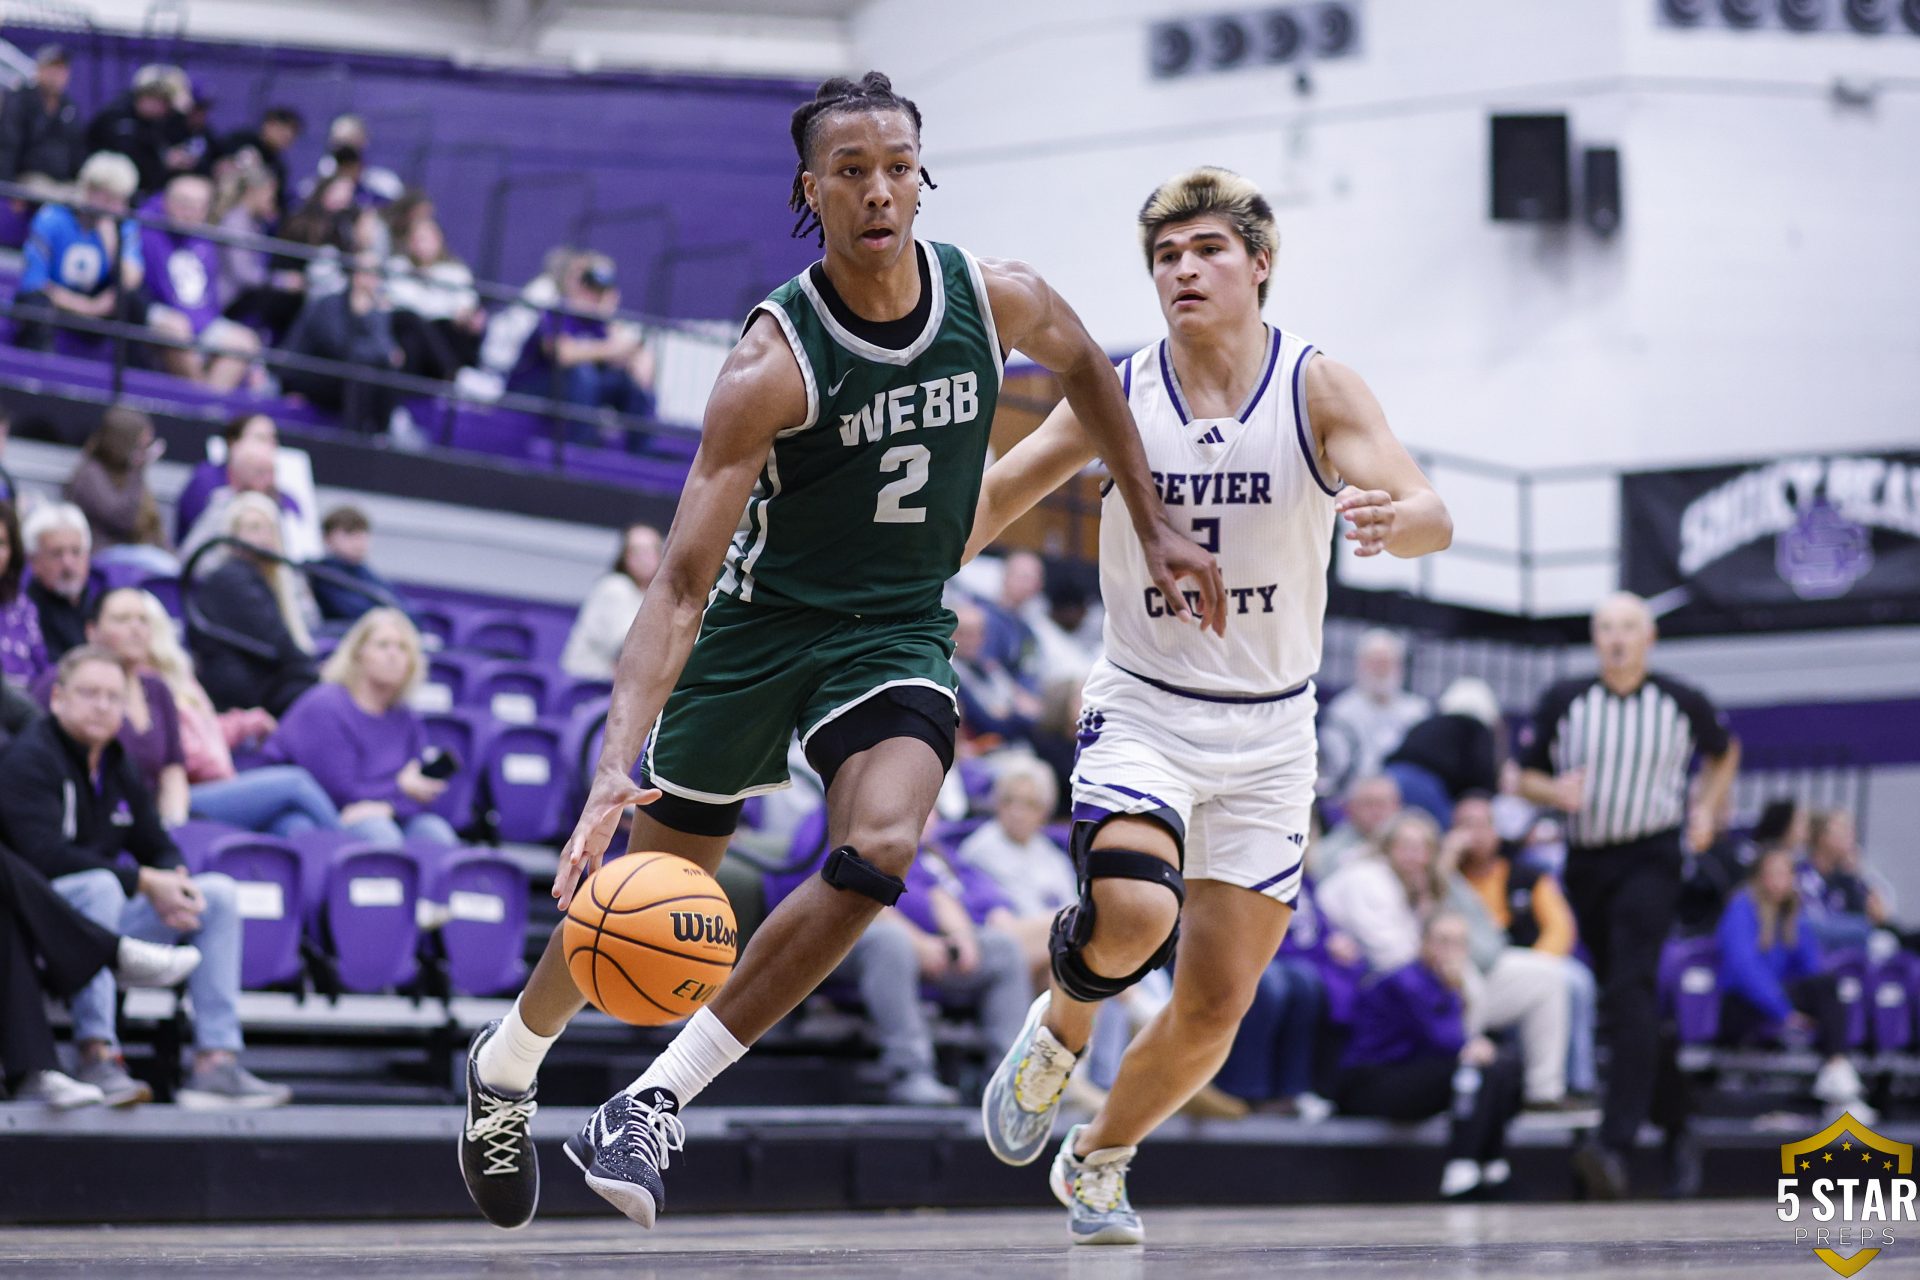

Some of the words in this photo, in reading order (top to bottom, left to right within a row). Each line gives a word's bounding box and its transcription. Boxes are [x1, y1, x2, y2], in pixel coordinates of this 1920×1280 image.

[839, 371, 978, 446] WEBB
[873, 444, 931, 523] 2
[670, 911, 737, 949] Wilso
[672, 979, 724, 1002] EV
